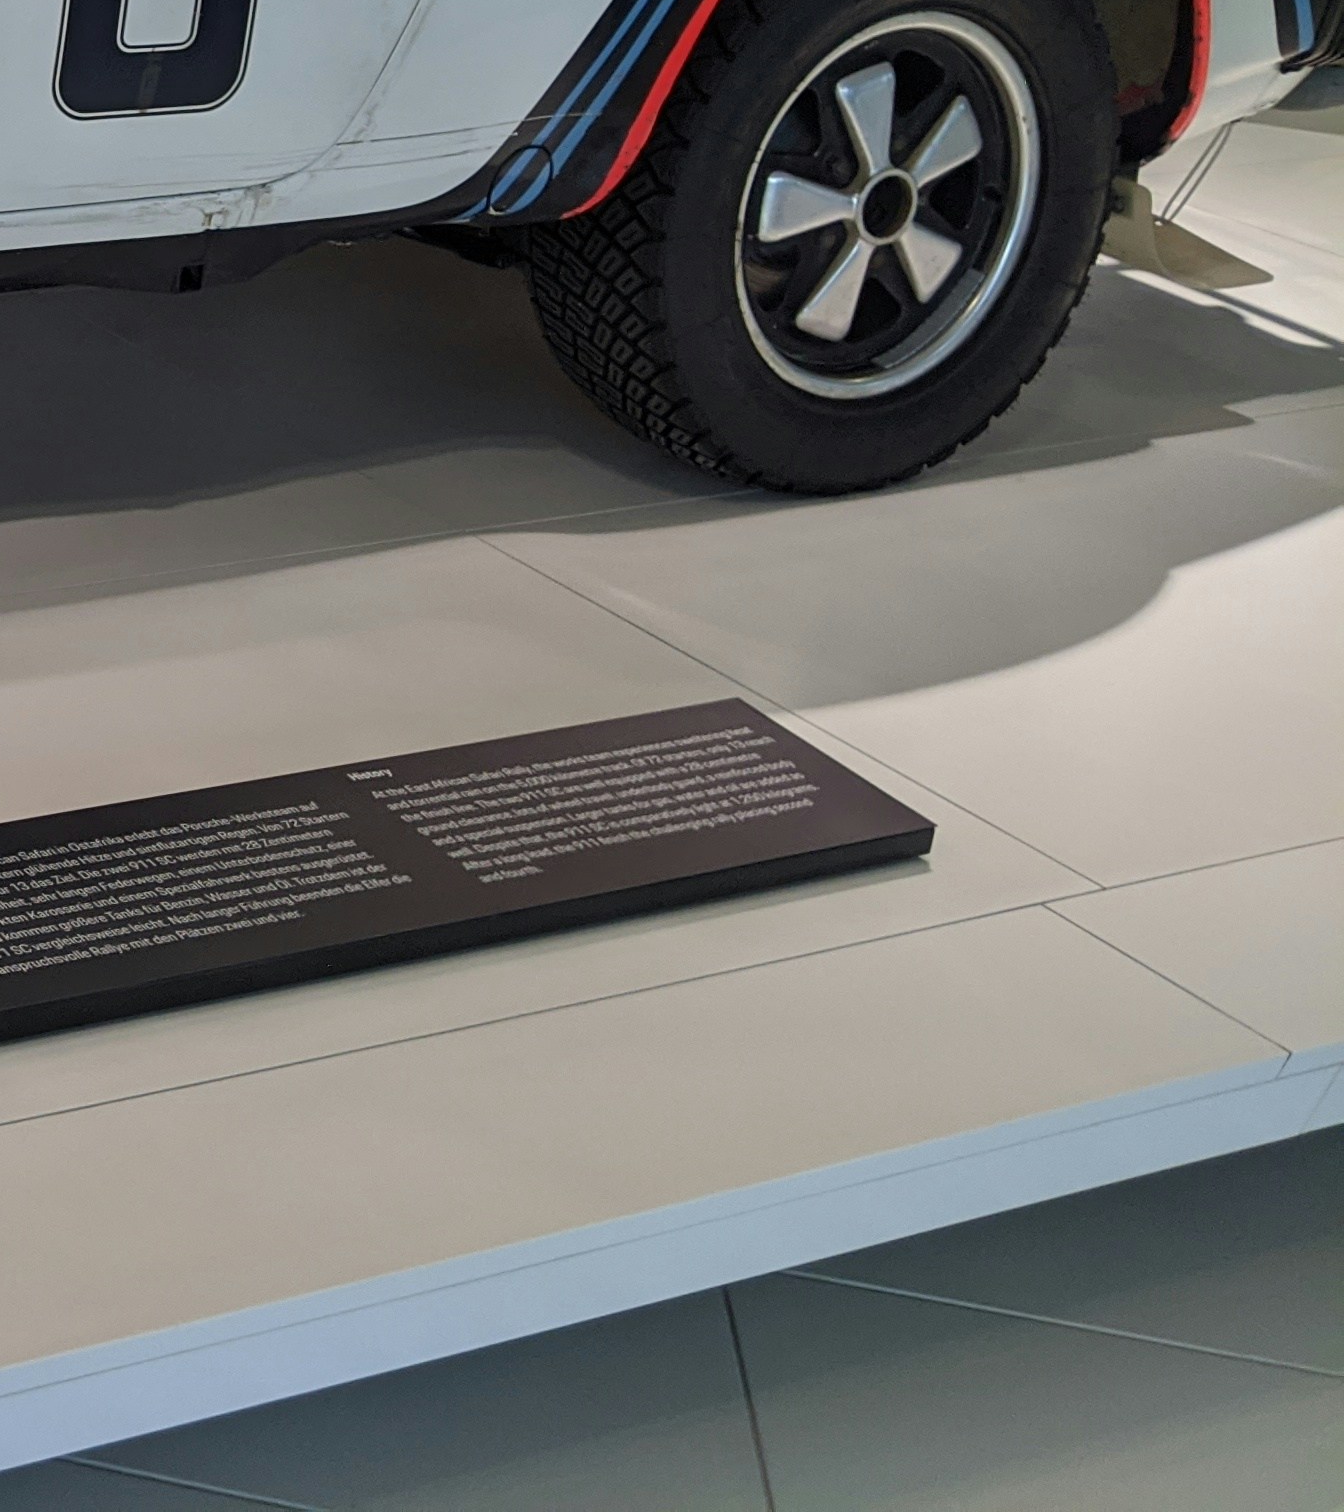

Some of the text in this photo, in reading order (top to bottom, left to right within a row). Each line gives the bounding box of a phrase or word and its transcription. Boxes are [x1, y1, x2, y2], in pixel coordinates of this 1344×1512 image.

[347, 769, 393, 781] History
[23, 859, 80, 877] glühende
[9, 881, 31, 892] 13
[29, 879, 54, 889] das
[29, 893, 58, 904] sehr
[26, 902, 94, 920] Karosserie
[0, 924, 59, 941] kommen
[58, 915, 108, 932] größere
[9, 943, 33, 955] SC
[88, 943, 131, 956] Rallye
